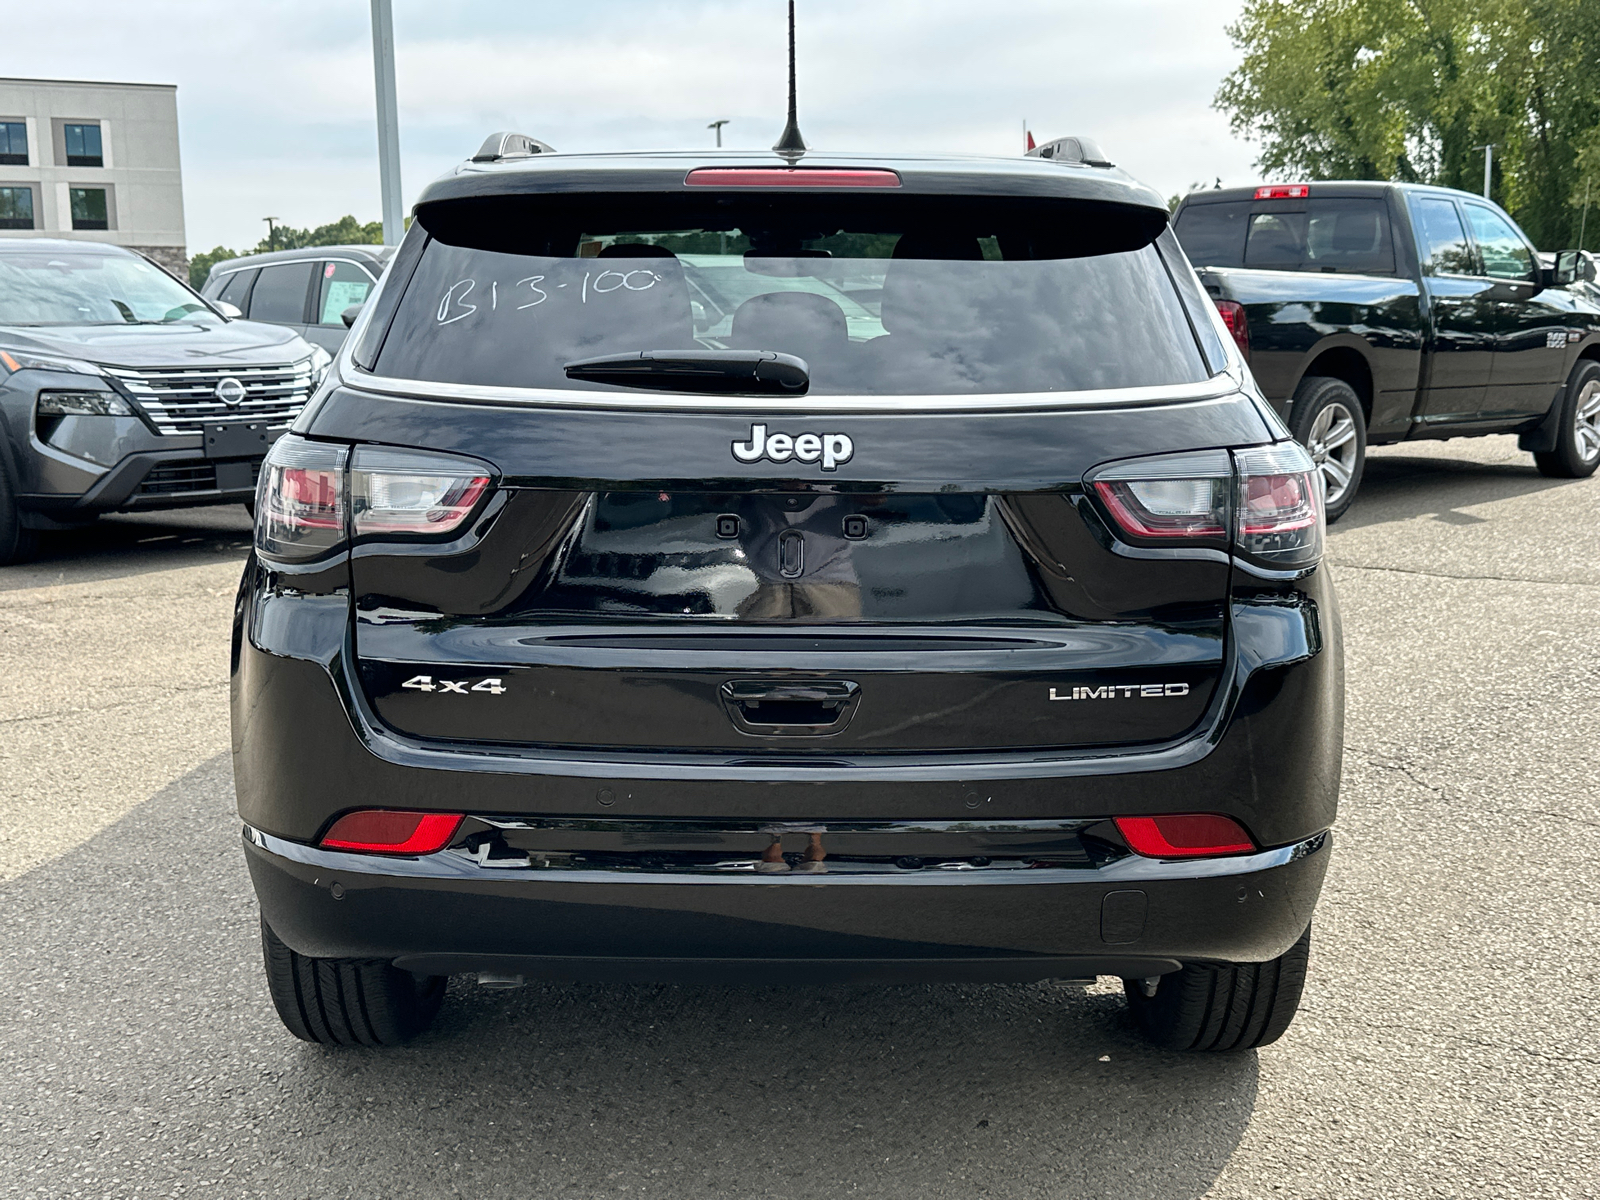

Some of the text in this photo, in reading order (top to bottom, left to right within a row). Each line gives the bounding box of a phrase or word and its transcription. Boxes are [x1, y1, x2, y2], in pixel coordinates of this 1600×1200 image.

[732, 424, 853, 469] Jeep
[402, 675, 507, 695] 4x4
[1049, 682, 1190, 700] LIMITED
